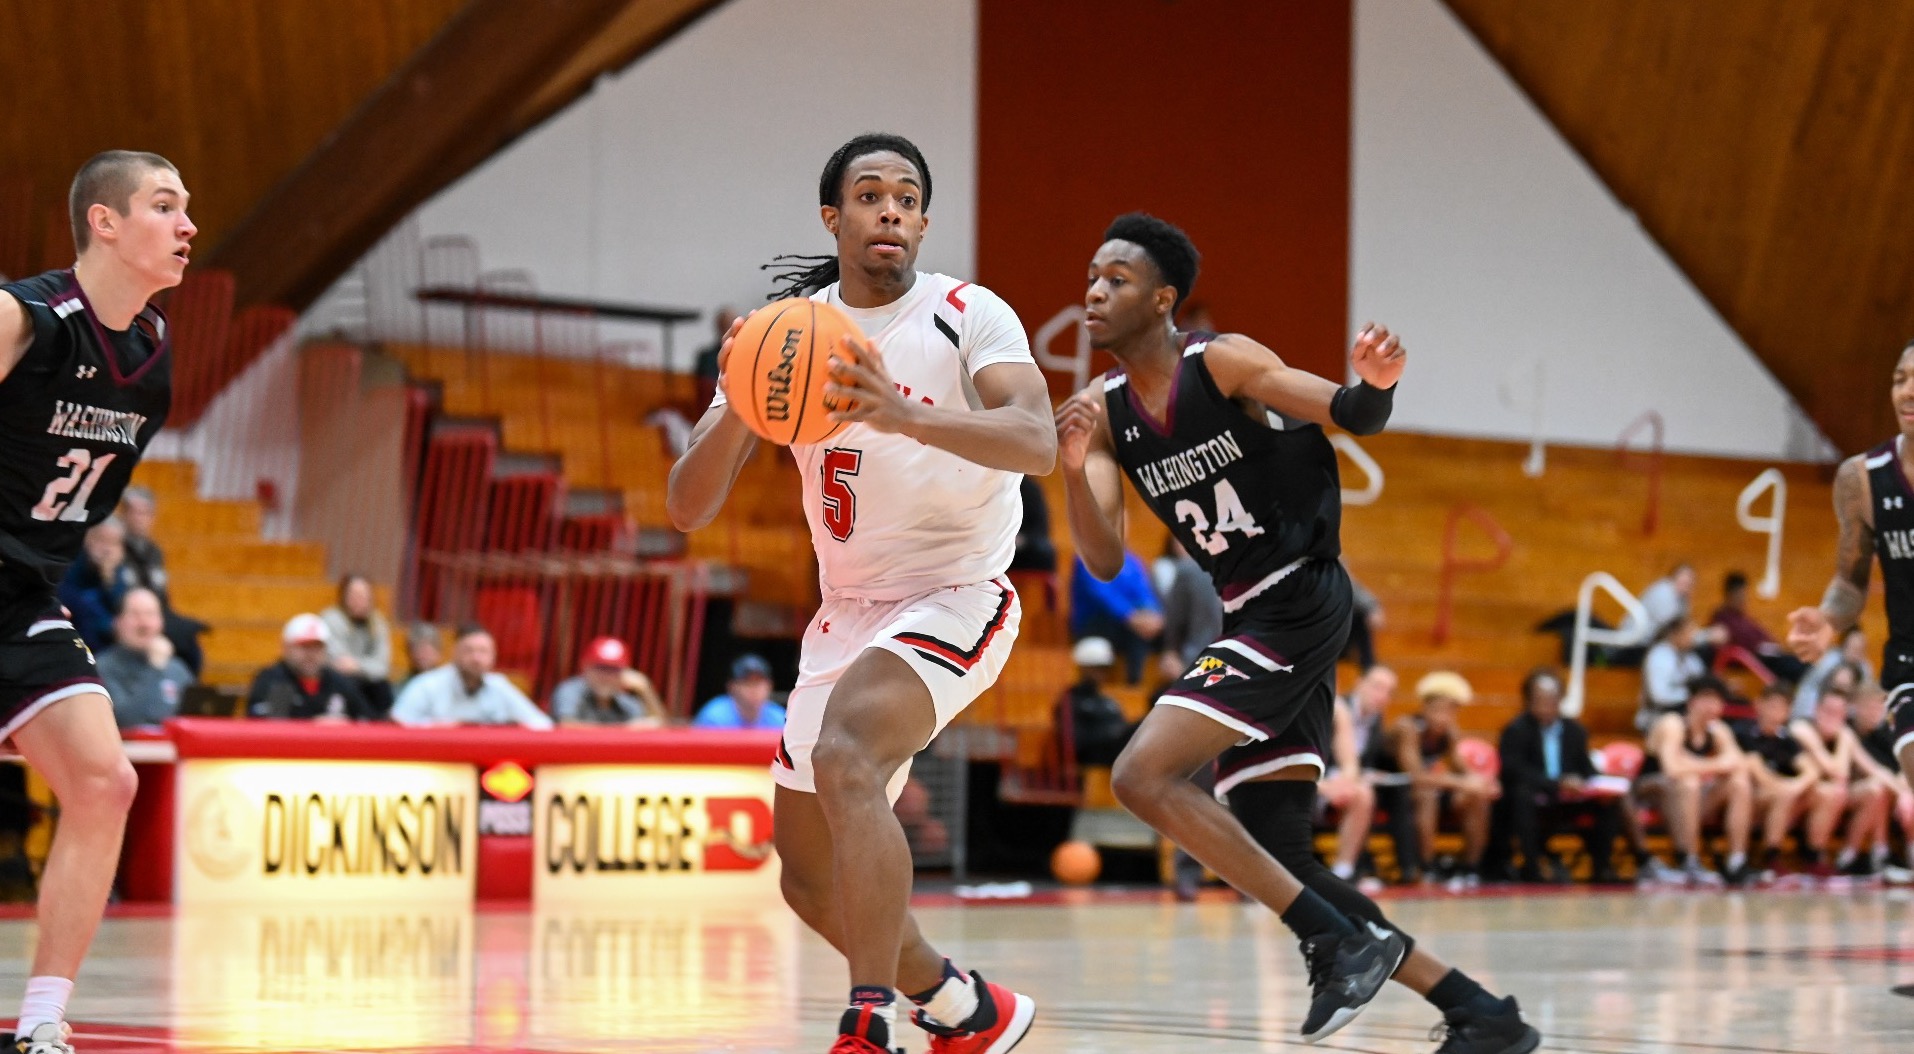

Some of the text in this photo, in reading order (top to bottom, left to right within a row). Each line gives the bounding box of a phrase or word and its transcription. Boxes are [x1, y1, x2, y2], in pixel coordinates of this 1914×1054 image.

[767, 330, 802, 421] Wilson
[31, 448, 117, 521] 21
[821, 447, 862, 542] 5
[1136, 430, 1243, 497] WAHINGTON
[1175, 478, 1265, 555] 24
[263, 794, 463, 874] DICKINSON
[547, 795, 692, 872] COLLEGE
